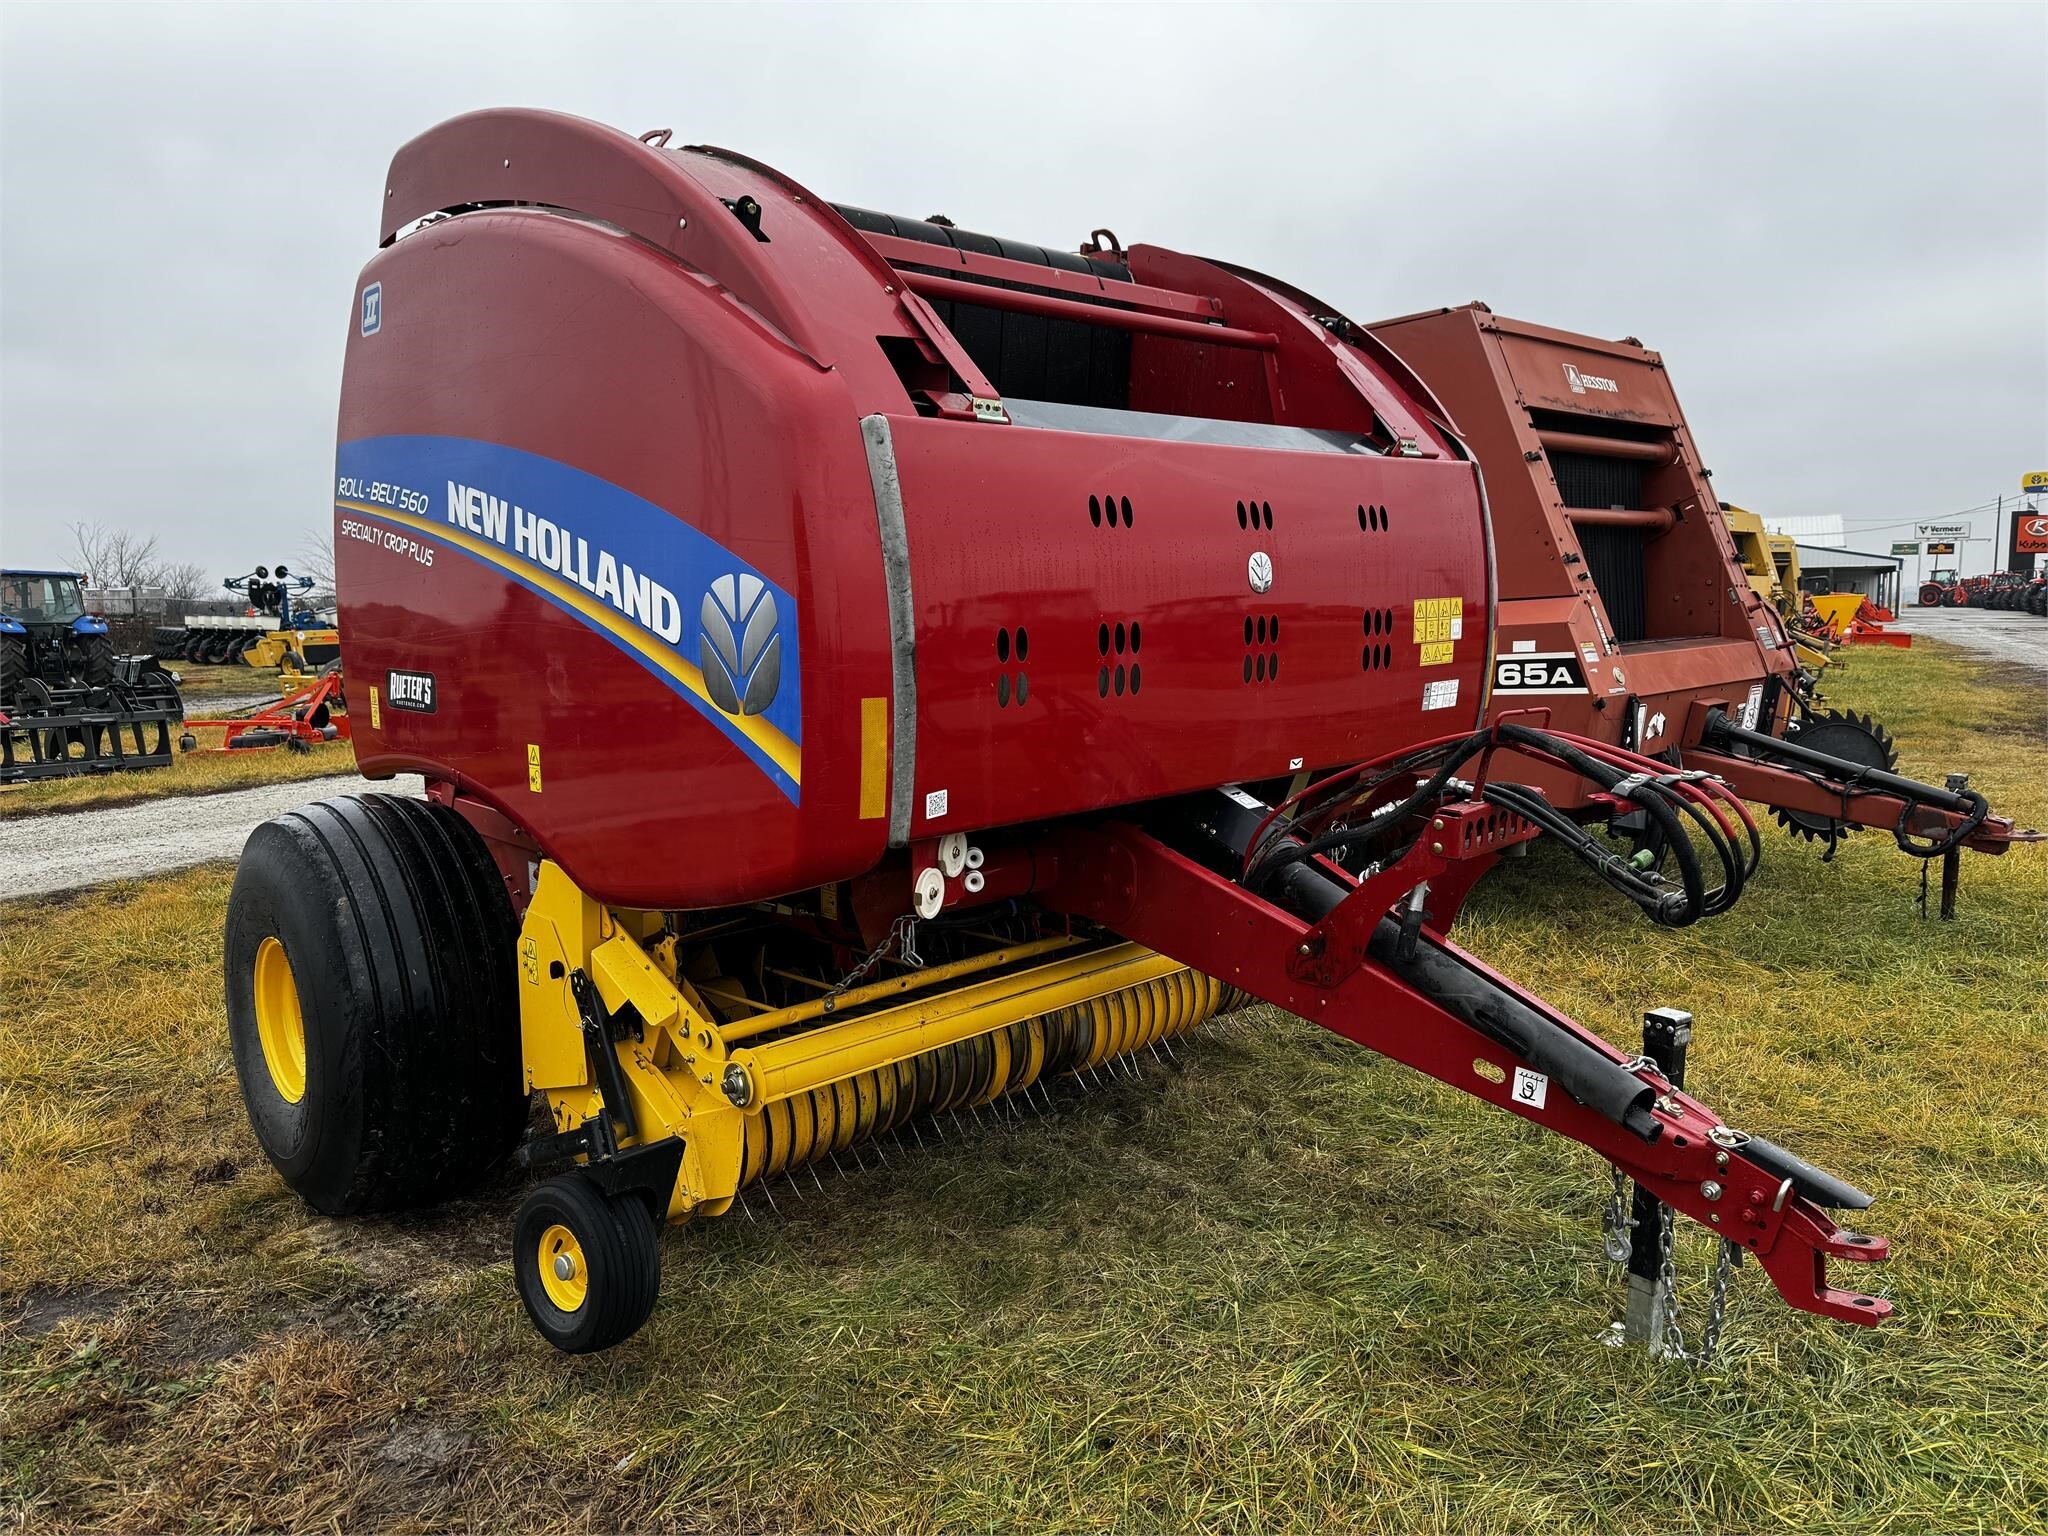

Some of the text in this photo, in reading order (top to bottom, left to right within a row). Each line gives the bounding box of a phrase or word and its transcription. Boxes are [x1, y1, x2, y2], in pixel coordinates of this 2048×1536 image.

[1580, 373, 1619, 393] HESSTON
[399, 488, 429, 514] 560
[1930, 525, 1963, 533] Vermeer
[341, 519, 434, 567] SPECIALTY CROP PLUS
[447, 480, 682, 645] NEW HOLLAND
[1498, 662, 1574, 686] 65A
[390, 672, 432, 705] RUETER'S
